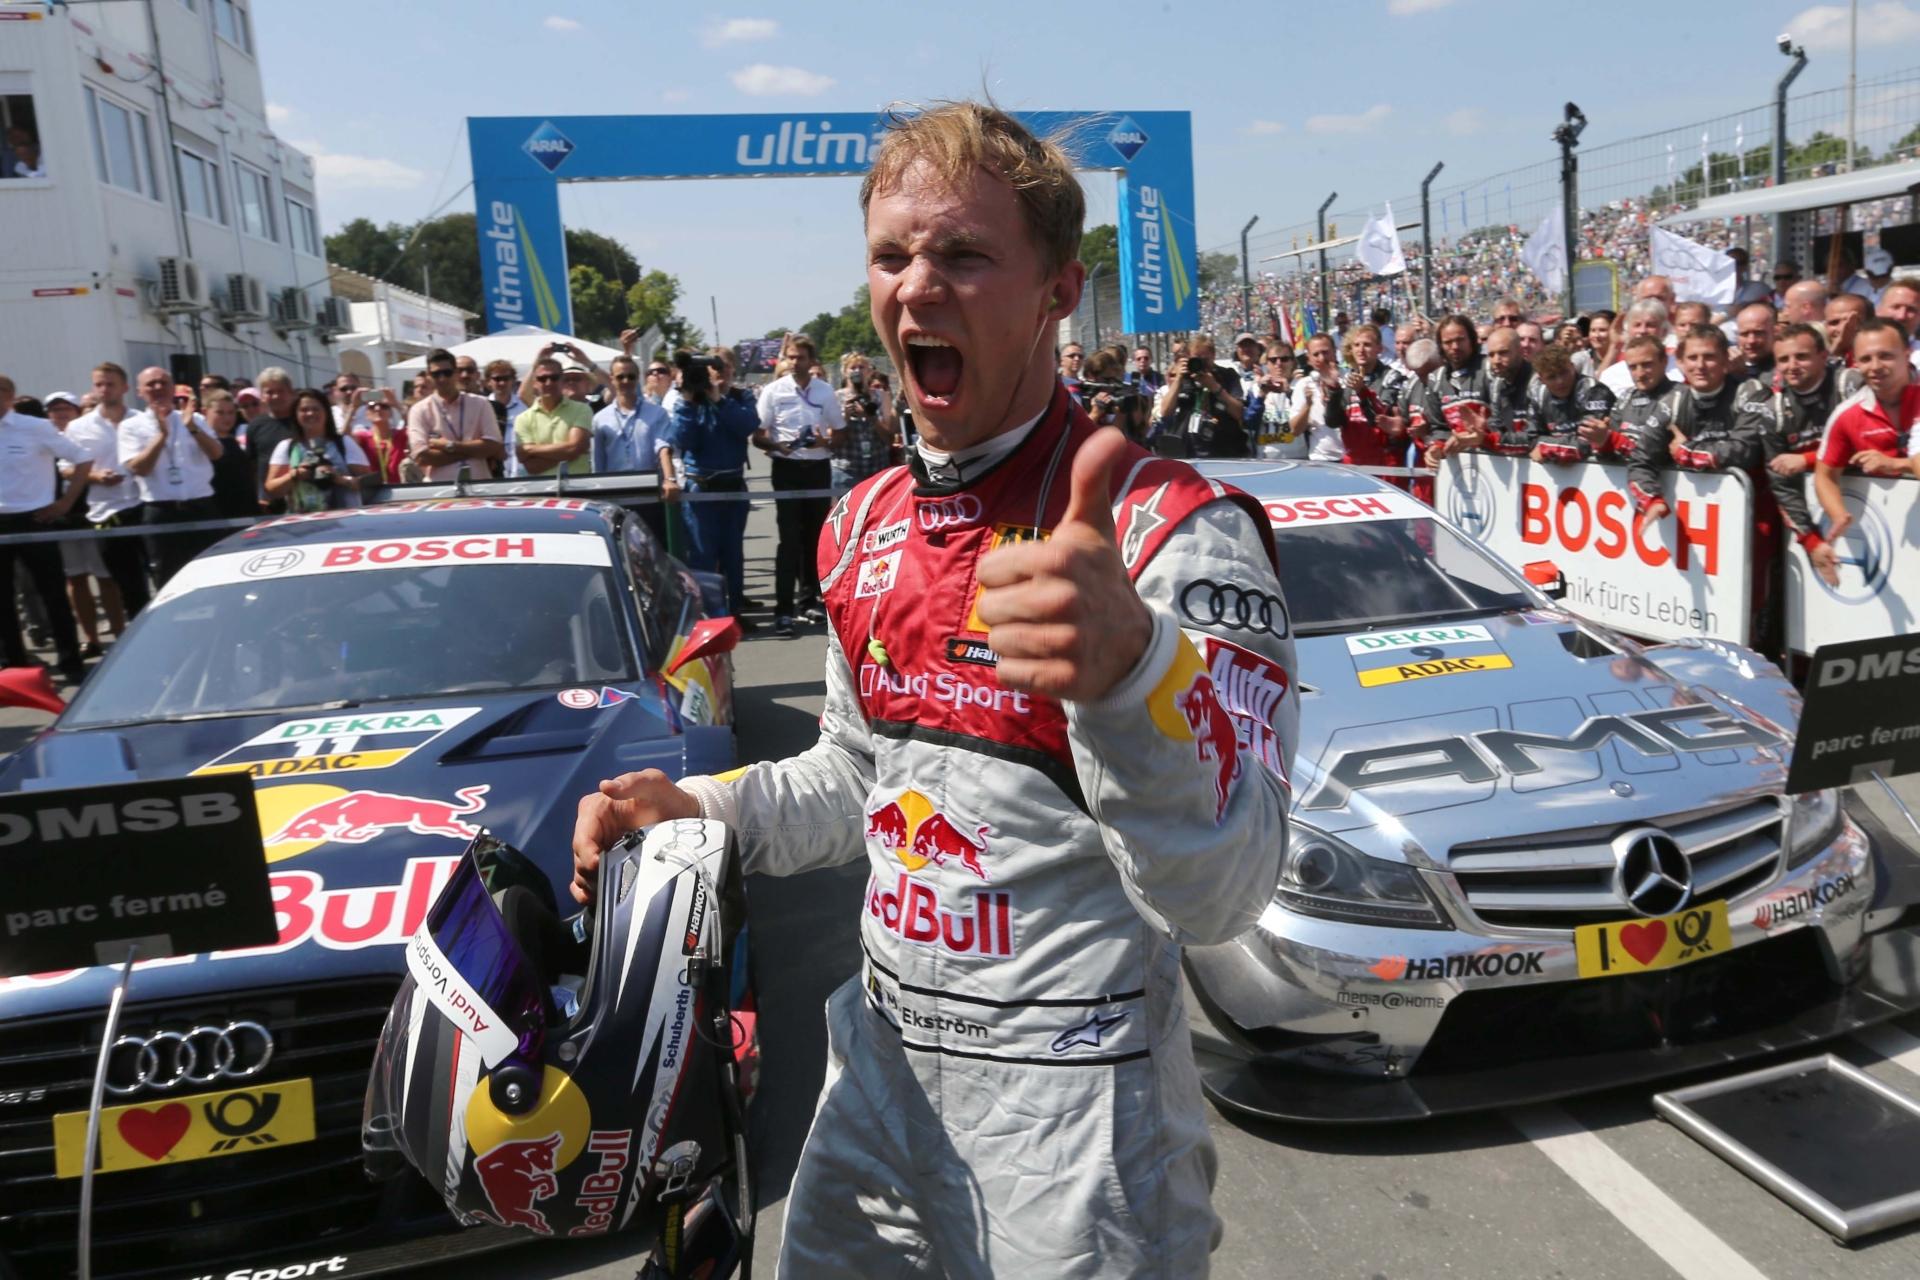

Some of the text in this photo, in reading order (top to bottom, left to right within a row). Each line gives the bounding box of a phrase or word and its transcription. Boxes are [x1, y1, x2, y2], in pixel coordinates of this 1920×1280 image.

[529, 140, 569, 152] ARAL
[1111, 132, 1145, 144] ARAL
[1136, 185, 1163, 314] ultimate
[1521, 483, 1720, 576] BOSCH
[321, 538, 535, 567] BOSCH
[1599, 581, 1640, 615] fürs
[1646, 592, 1718, 634] Leben
[1357, 628, 1482, 649] DEKRA
[1398, 658, 1485, 679] ADAC
[935, 672, 1030, 714] Sport
[280, 713, 444, 738] DEKRA
[291, 735, 361, 759] 11
[1301, 704, 1784, 811] AMG
[1812, 733, 1864, 760] parc
[246, 754, 360, 777] ADAC
[5, 883, 226, 936] parc fermé
[1405, 952, 1545, 980] Hankook
[447, 988, 489, 1033] Audi
[1337, 991, 1444, 1010] media@home
[663, 989, 690, 1068] Schuberth
[903, 1007, 989, 1039] Ekström
